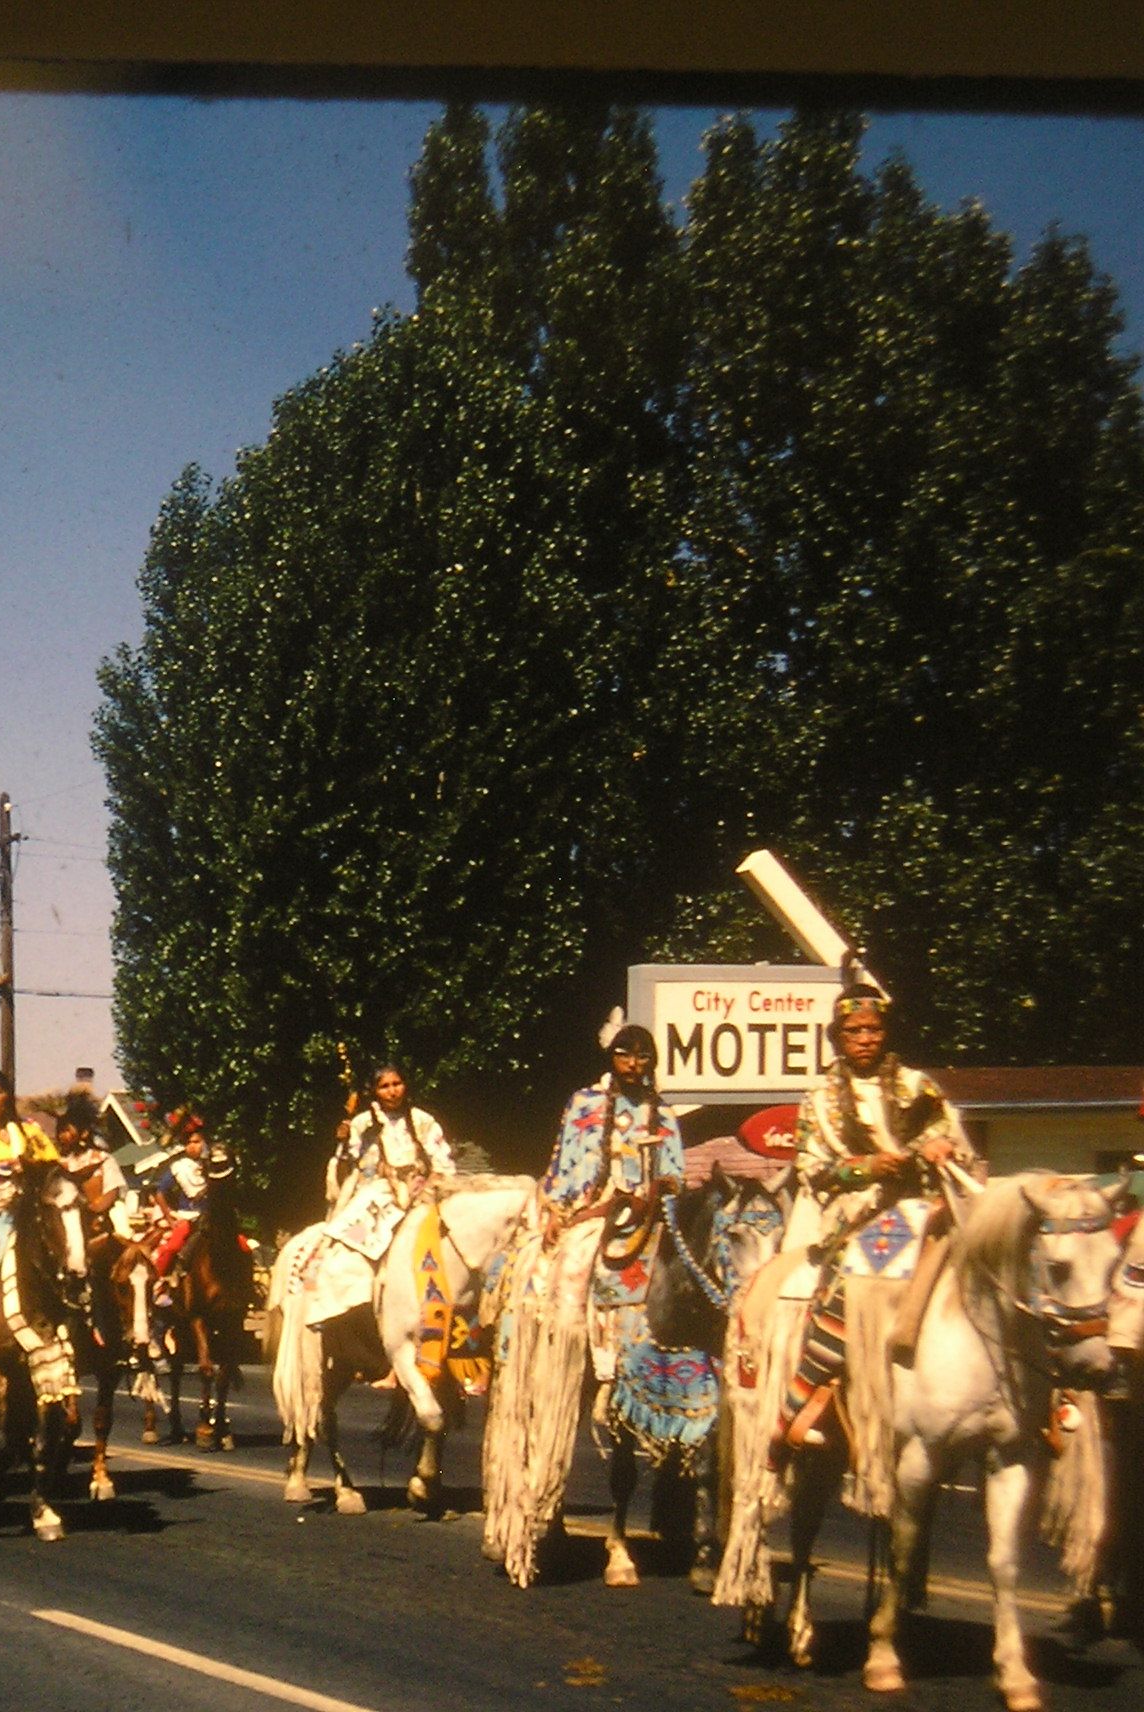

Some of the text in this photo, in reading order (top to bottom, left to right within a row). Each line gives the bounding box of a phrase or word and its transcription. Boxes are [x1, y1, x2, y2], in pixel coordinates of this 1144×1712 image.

[692, 990, 815, 1019] City Center
[666, 1022, 833, 1078] MOTEL
